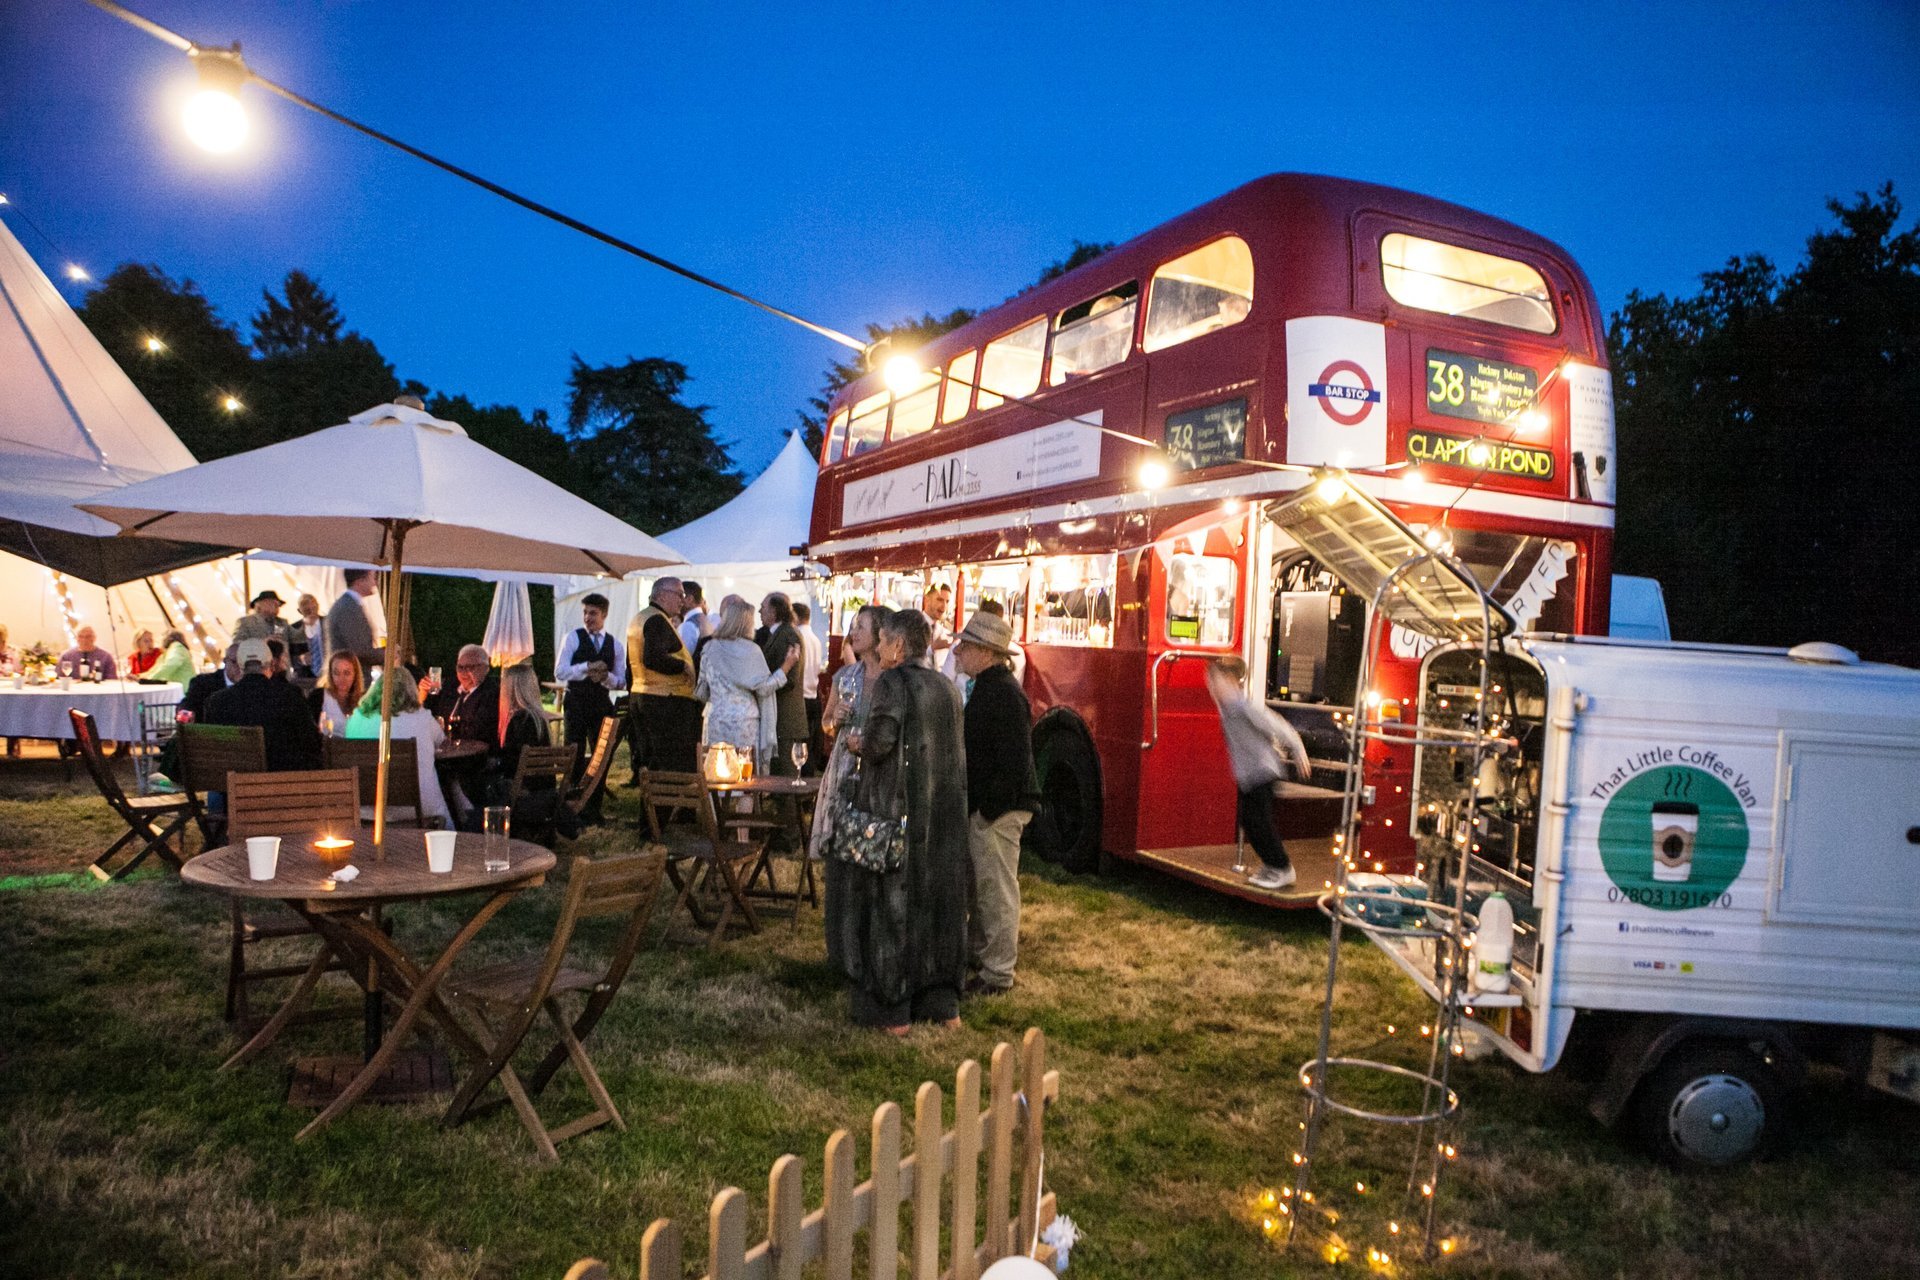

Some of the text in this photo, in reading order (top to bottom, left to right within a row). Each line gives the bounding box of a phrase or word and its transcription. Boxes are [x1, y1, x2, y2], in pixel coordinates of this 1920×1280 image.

[1325, 385, 1369, 400] BAR STOP
[1428, 359, 1465, 407] 38
[1500, 447, 1551, 476] POND
[1590, 745, 1757, 808] That Little Coffee Van
[1608, 886, 1732, 910] 07803 191670
